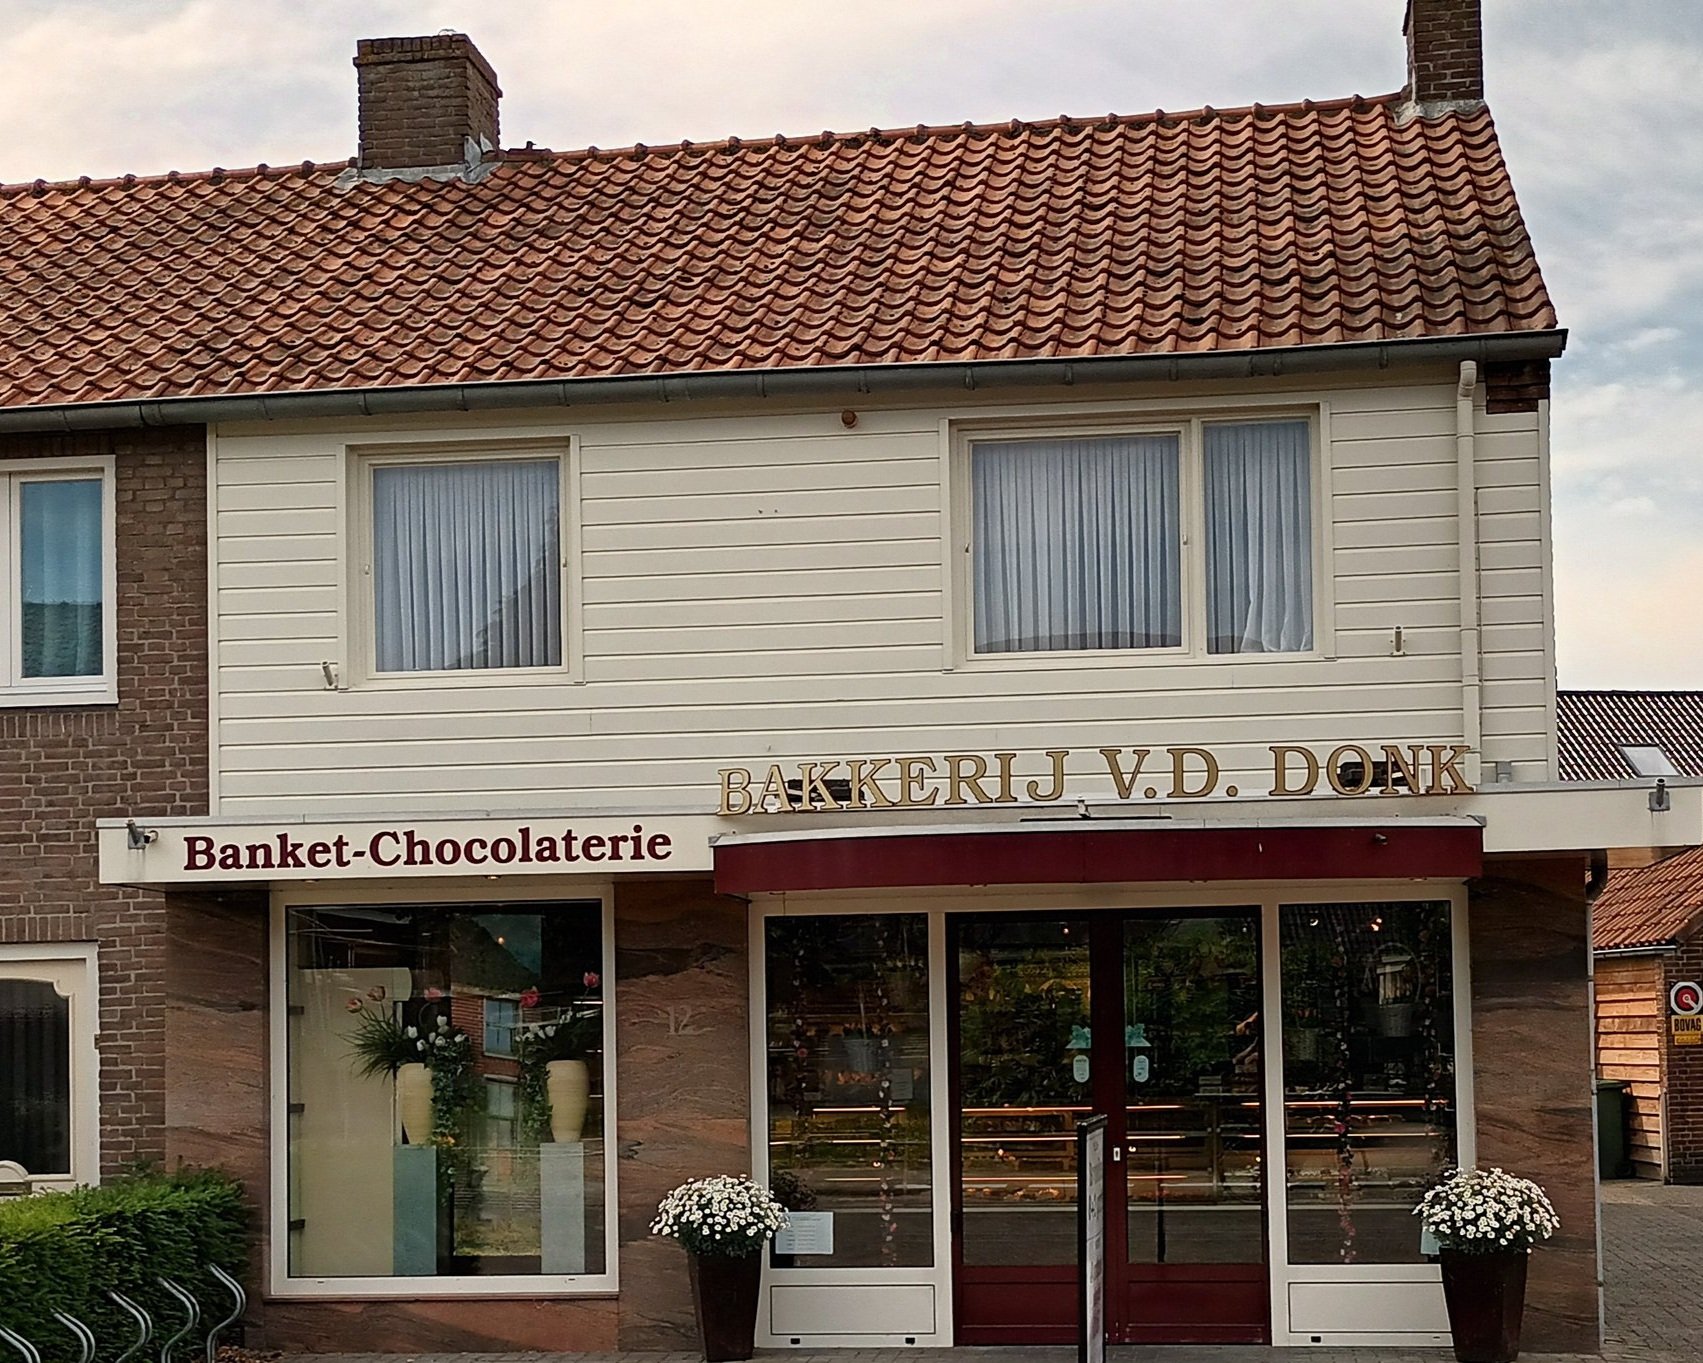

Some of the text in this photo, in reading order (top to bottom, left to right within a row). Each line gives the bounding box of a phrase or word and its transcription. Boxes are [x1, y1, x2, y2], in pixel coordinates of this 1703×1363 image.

[716, 744, 1475, 816] BAKKERIJ V.D. DONK
[183, 824, 673, 871] Banket-Chocolaterie
[1674, 1018, 1702, 1032] BOVAG
